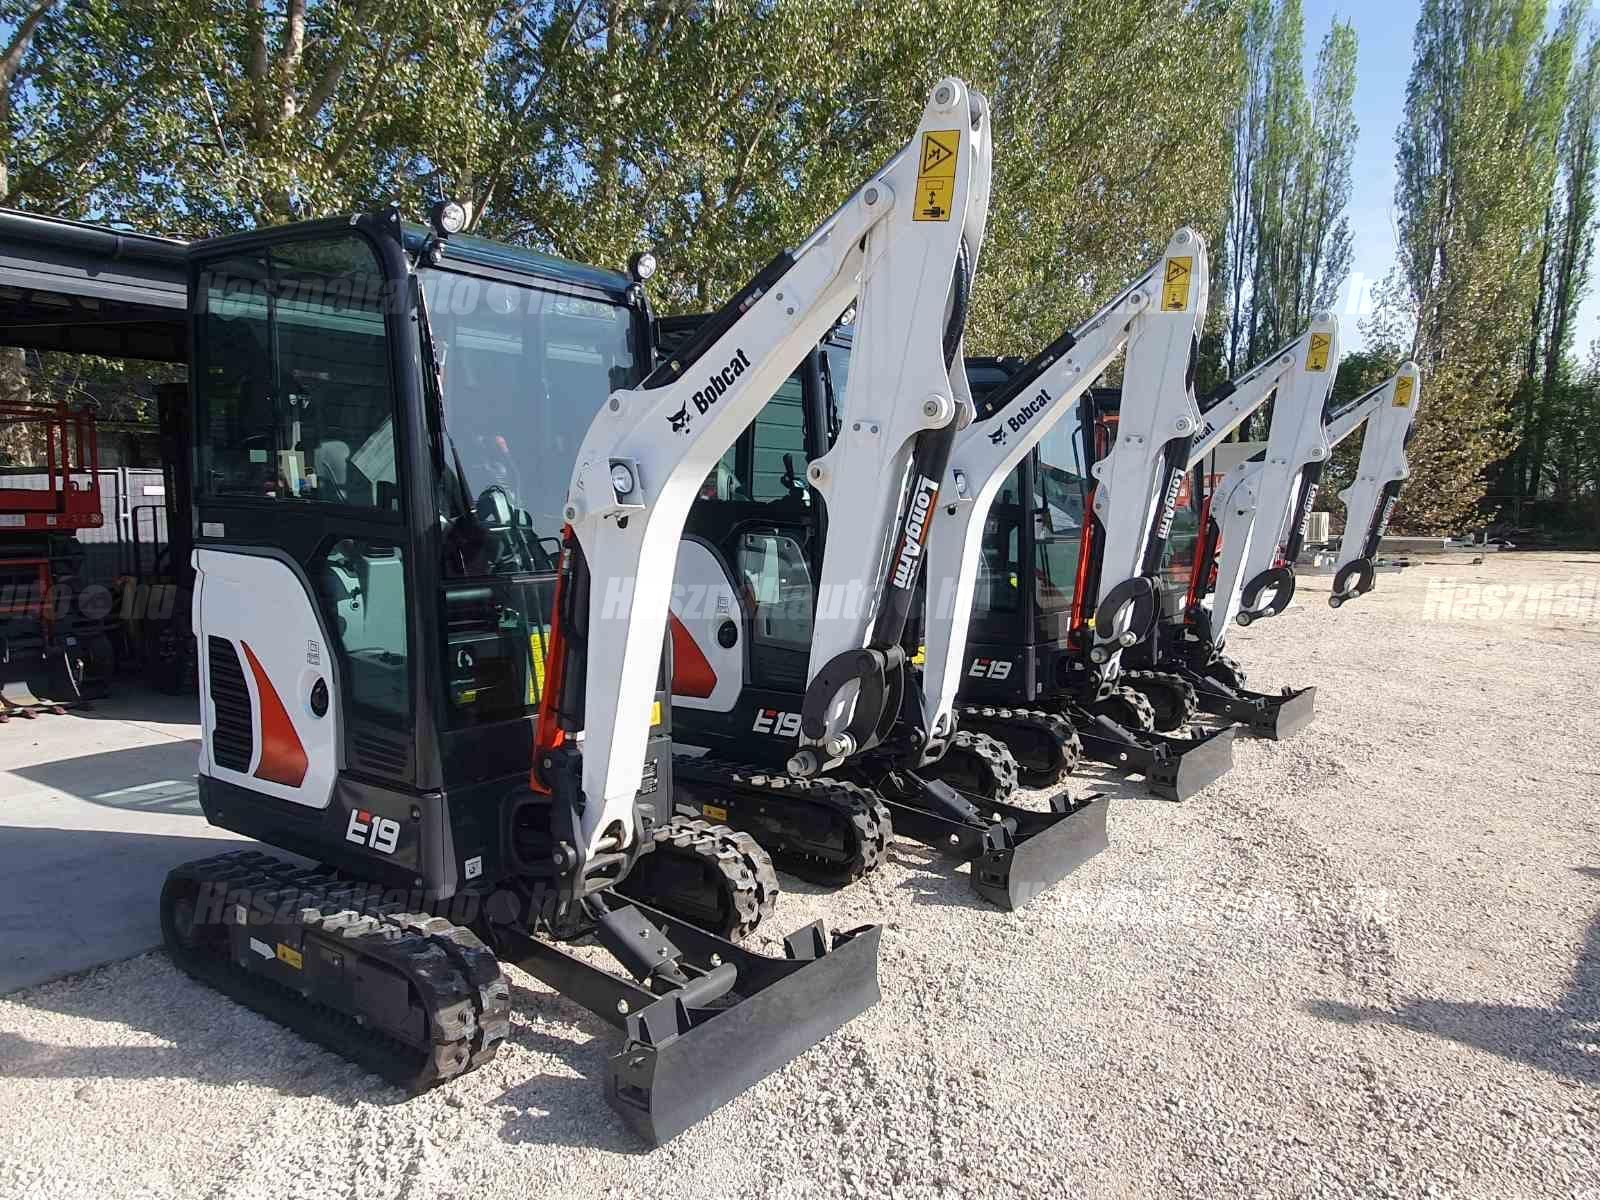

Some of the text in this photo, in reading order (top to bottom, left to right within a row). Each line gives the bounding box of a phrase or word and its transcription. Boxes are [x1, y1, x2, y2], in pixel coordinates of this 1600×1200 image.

[692, 348, 751, 416] Bobcat
[1007, 388, 1052, 433] Bobcat
[1157, 466, 1185, 540] LongArm
[893, 474, 940, 590] LongArm
[968, 658, 1013, 680] E19
[752, 708, 802, 738] E19
[345, 808, 401, 855] E19
